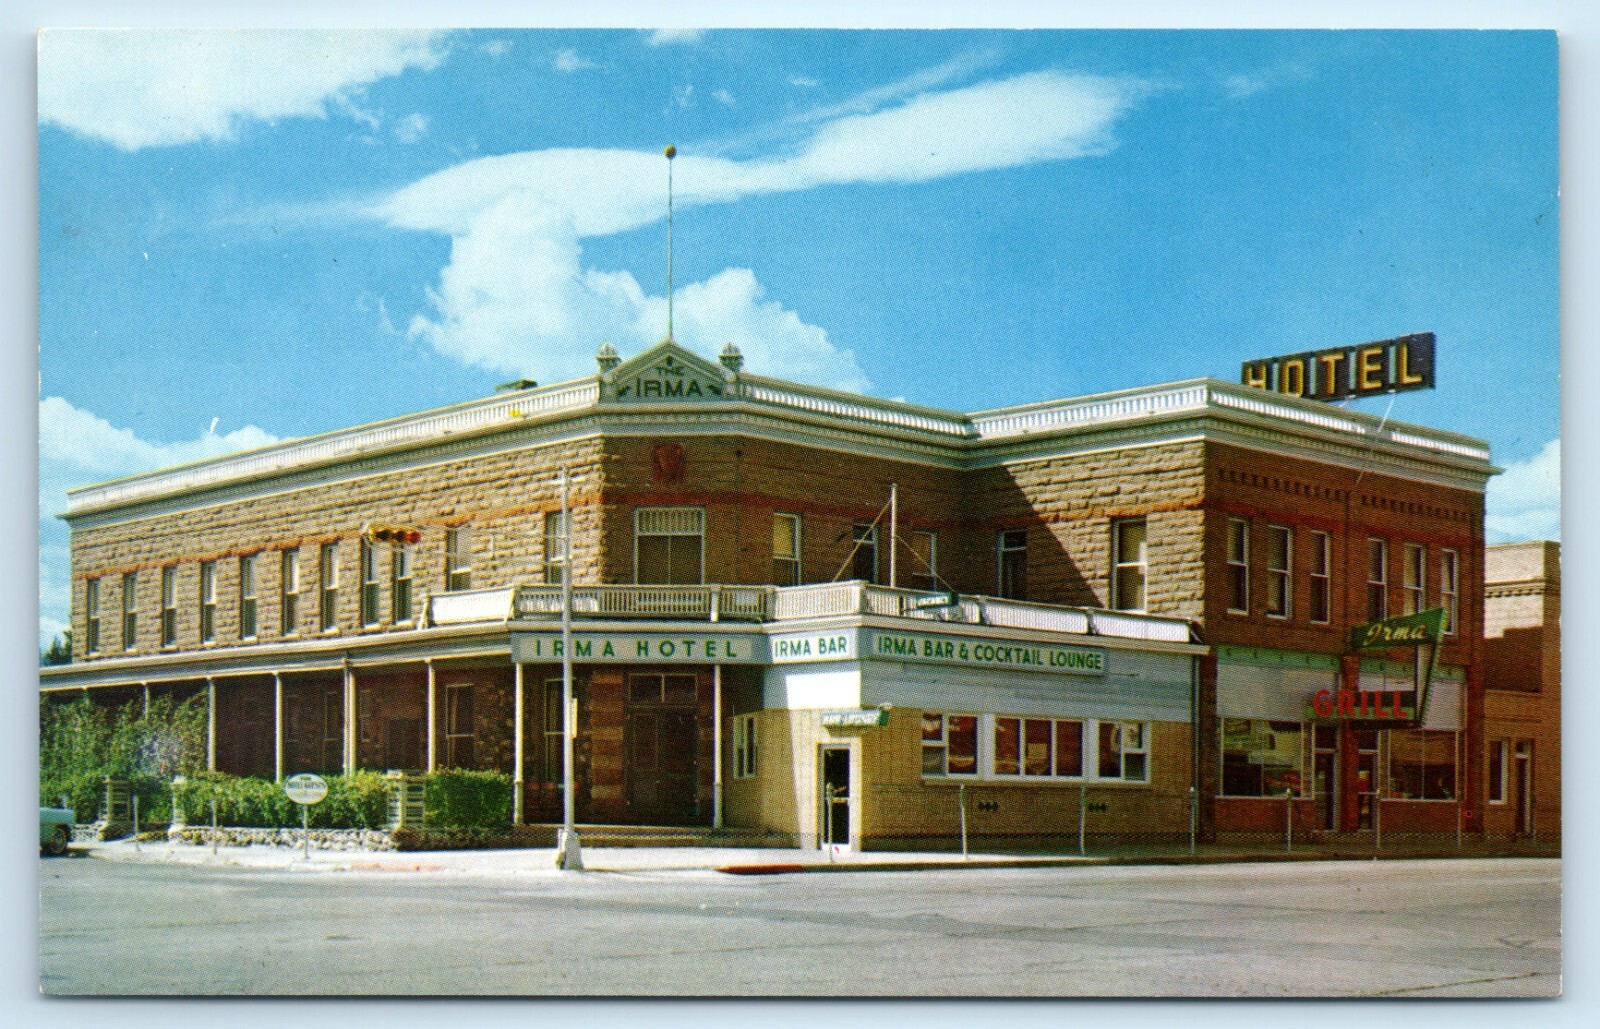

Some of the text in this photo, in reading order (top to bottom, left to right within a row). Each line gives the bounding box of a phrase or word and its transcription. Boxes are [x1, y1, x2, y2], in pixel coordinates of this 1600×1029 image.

[1243, 343, 1423, 398] HOTEL
[636, 377, 703, 396] IRMA
[1363, 623, 1427, 646] Irma
[535, 639, 738, 658] IRMA HOTEL
[773, 635, 848, 658] IRMA BAR
[877, 635, 1102, 671] IRMA BAR & COCKTAIL LOUNGE
[1312, 688, 1409, 718] GRILL
